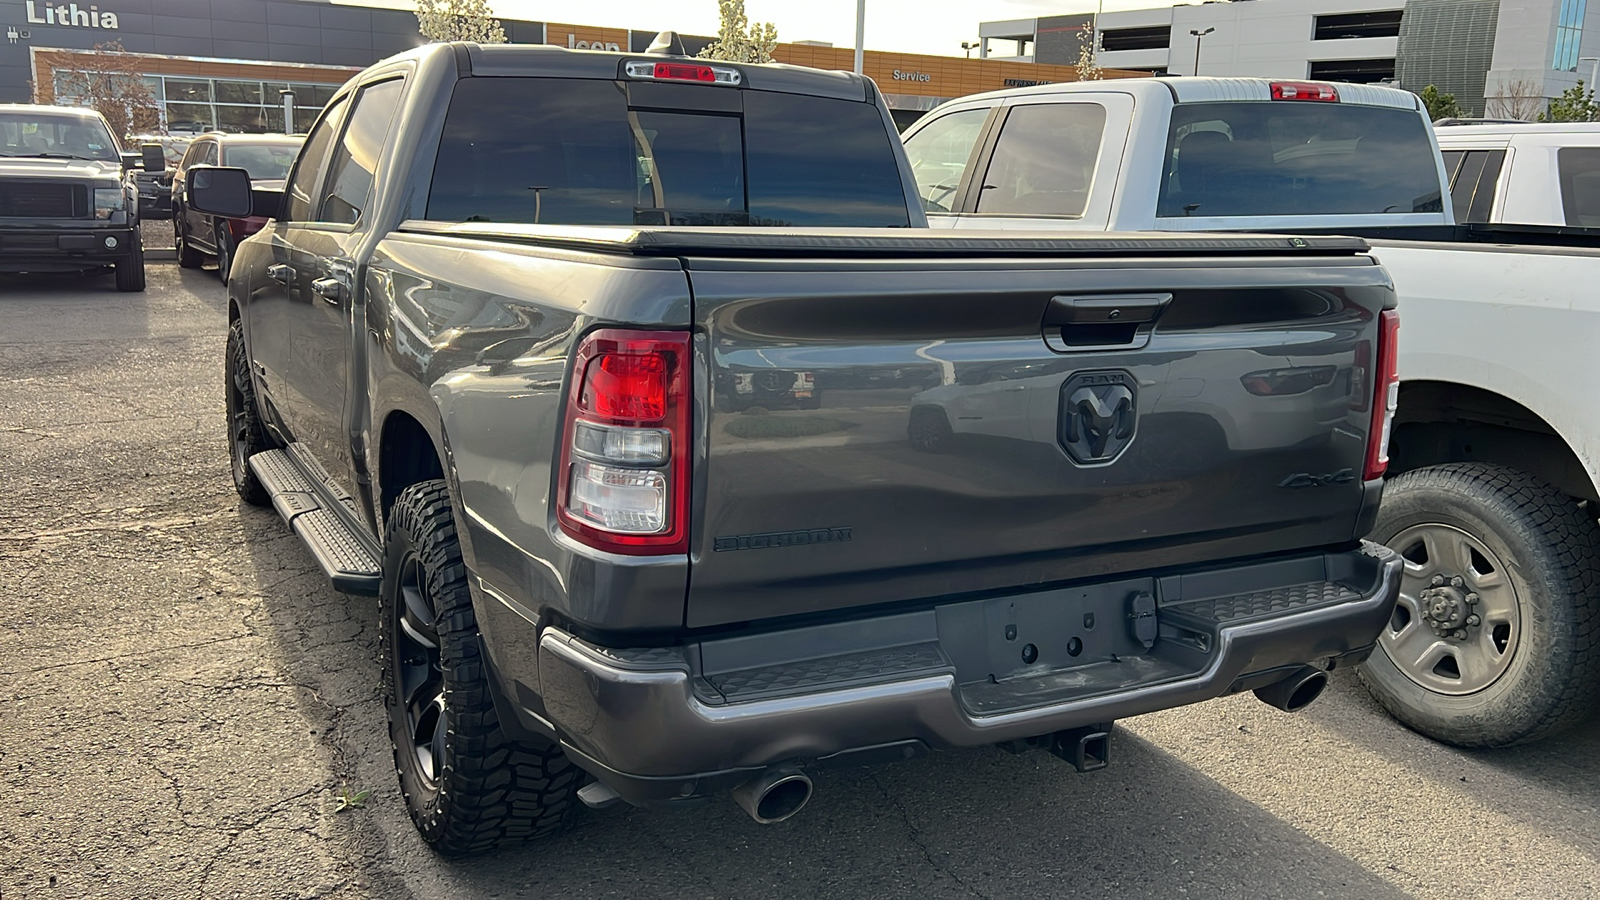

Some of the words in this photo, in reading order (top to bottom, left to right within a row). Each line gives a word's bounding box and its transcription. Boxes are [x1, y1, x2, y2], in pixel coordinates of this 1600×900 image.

[26, 0, 119, 29] Lithia
[892, 69, 931, 82] Service
[1080, 374, 1124, 384] RAM
